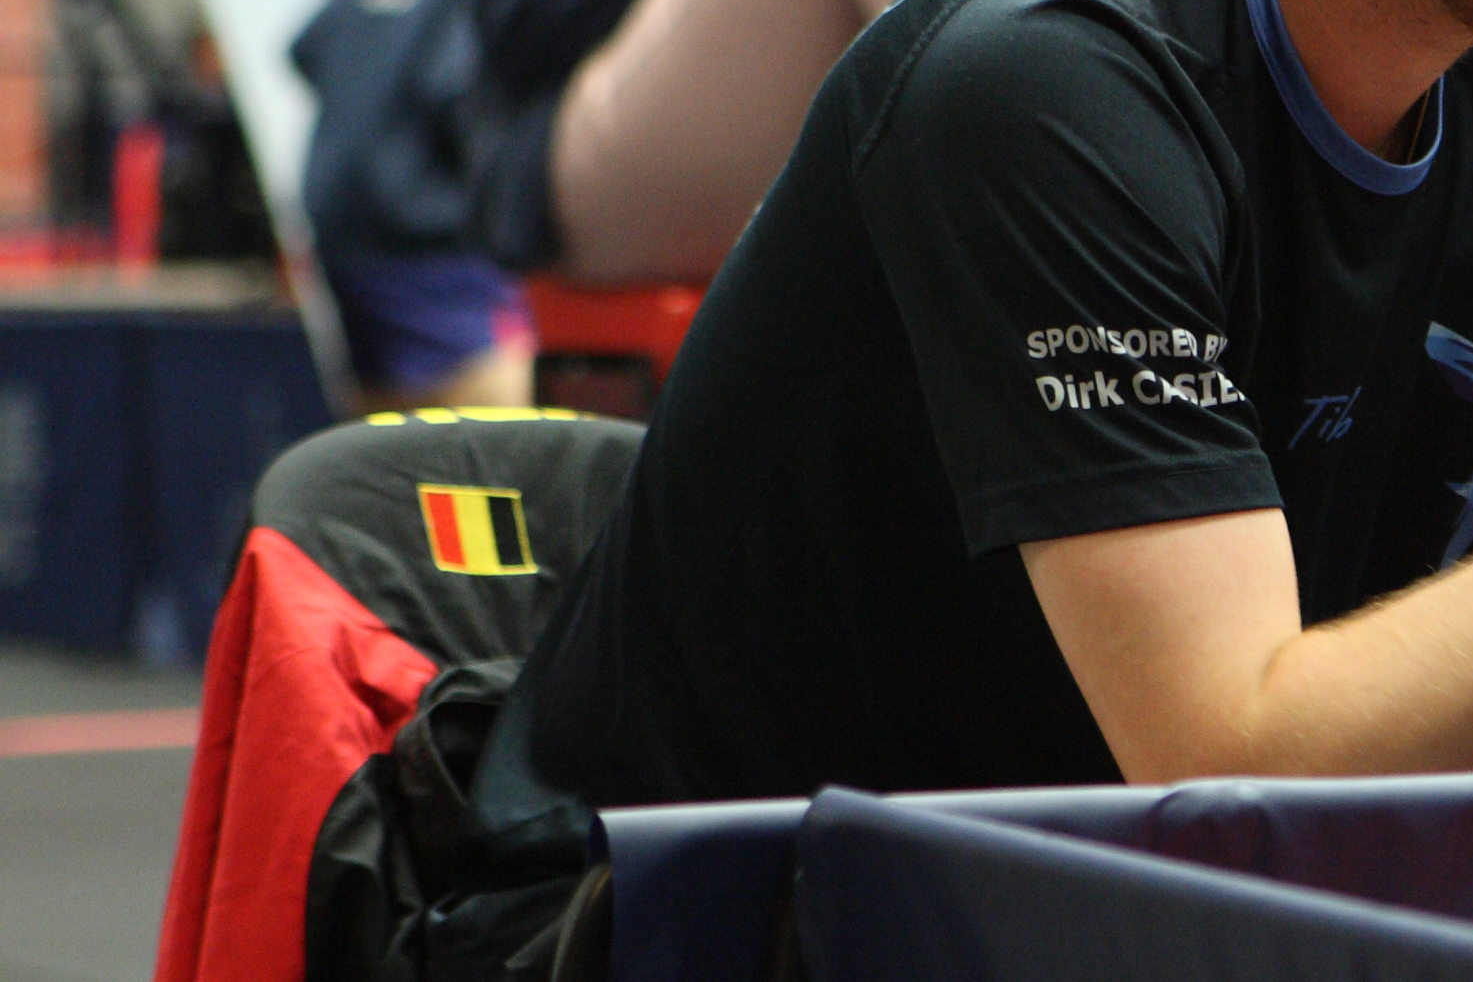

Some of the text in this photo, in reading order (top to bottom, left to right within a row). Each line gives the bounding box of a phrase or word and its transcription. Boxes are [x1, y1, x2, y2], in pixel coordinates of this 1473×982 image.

[1027, 324, 1228, 362] SPONSORED BY
[1036, 370, 1246, 412] Dirk CASIE
